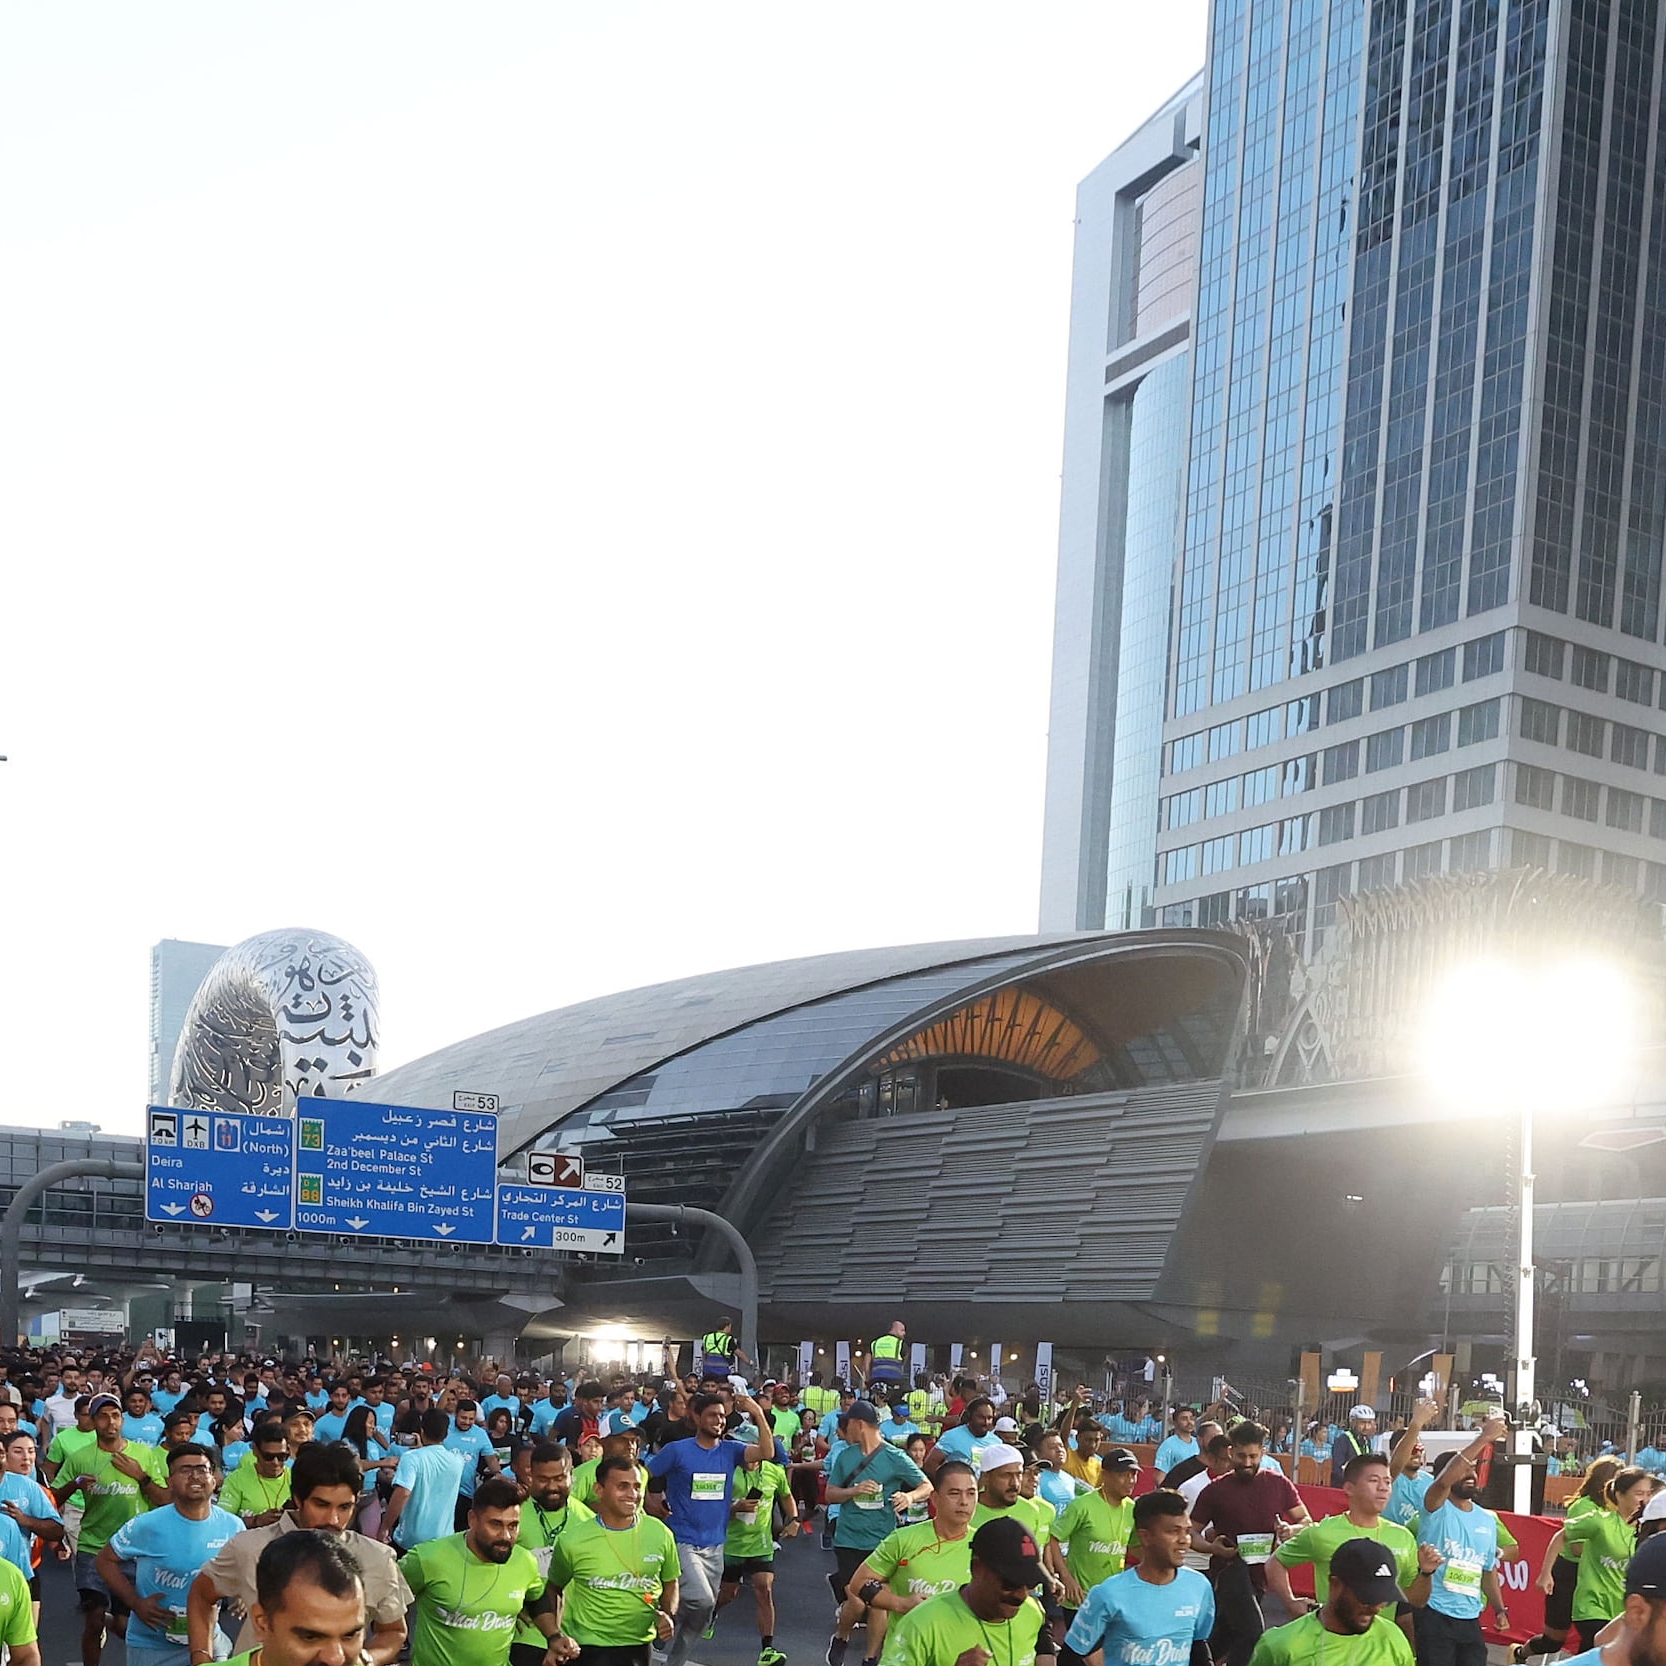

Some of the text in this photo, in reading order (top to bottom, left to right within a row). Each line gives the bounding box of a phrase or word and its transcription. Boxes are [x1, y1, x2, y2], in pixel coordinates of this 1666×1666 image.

[477, 1096, 495, 1110] 53
[382, 1109, 495, 1133] شارع قصر زعبيل
[187, 1140, 205, 1149] DXB
[303, 1133, 320, 1147] 73
[352, 1131, 494, 1153] شارع الثاني من ديسمبر
[243, 1141, 289, 1158] (North)
[327, 1145, 434, 1165] Zaa'beel Palace St
[152, 1155, 183, 1169] Deira
[263, 1162, 290, 1176] ديرة
[327, 1159, 422, 1177] 2nd December St
[152, 1177, 213, 1193] Al Sharjah
[241, 1181, 290, 1197] الشارقة
[327, 1176, 493, 1202] شارع الشيخ خليفة بن زايد
[606, 1177, 621, 1190] 52
[502, 1191, 547, 1205] التجاري
[591, 1199, 622, 1212] شارع
[326, 1196, 475, 1218] Sheikh Khalifa Bin Zayed St
[297, 1212, 336, 1225] 1000m
[501, 1209, 579, 1225] Trade Center St
[555, 1231, 586, 1242] 300m
[155, 1567, 188, 1589] Mai
[908, 1578, 939, 1595] Mai
[1122, 1642, 1155, 1664] Mai
